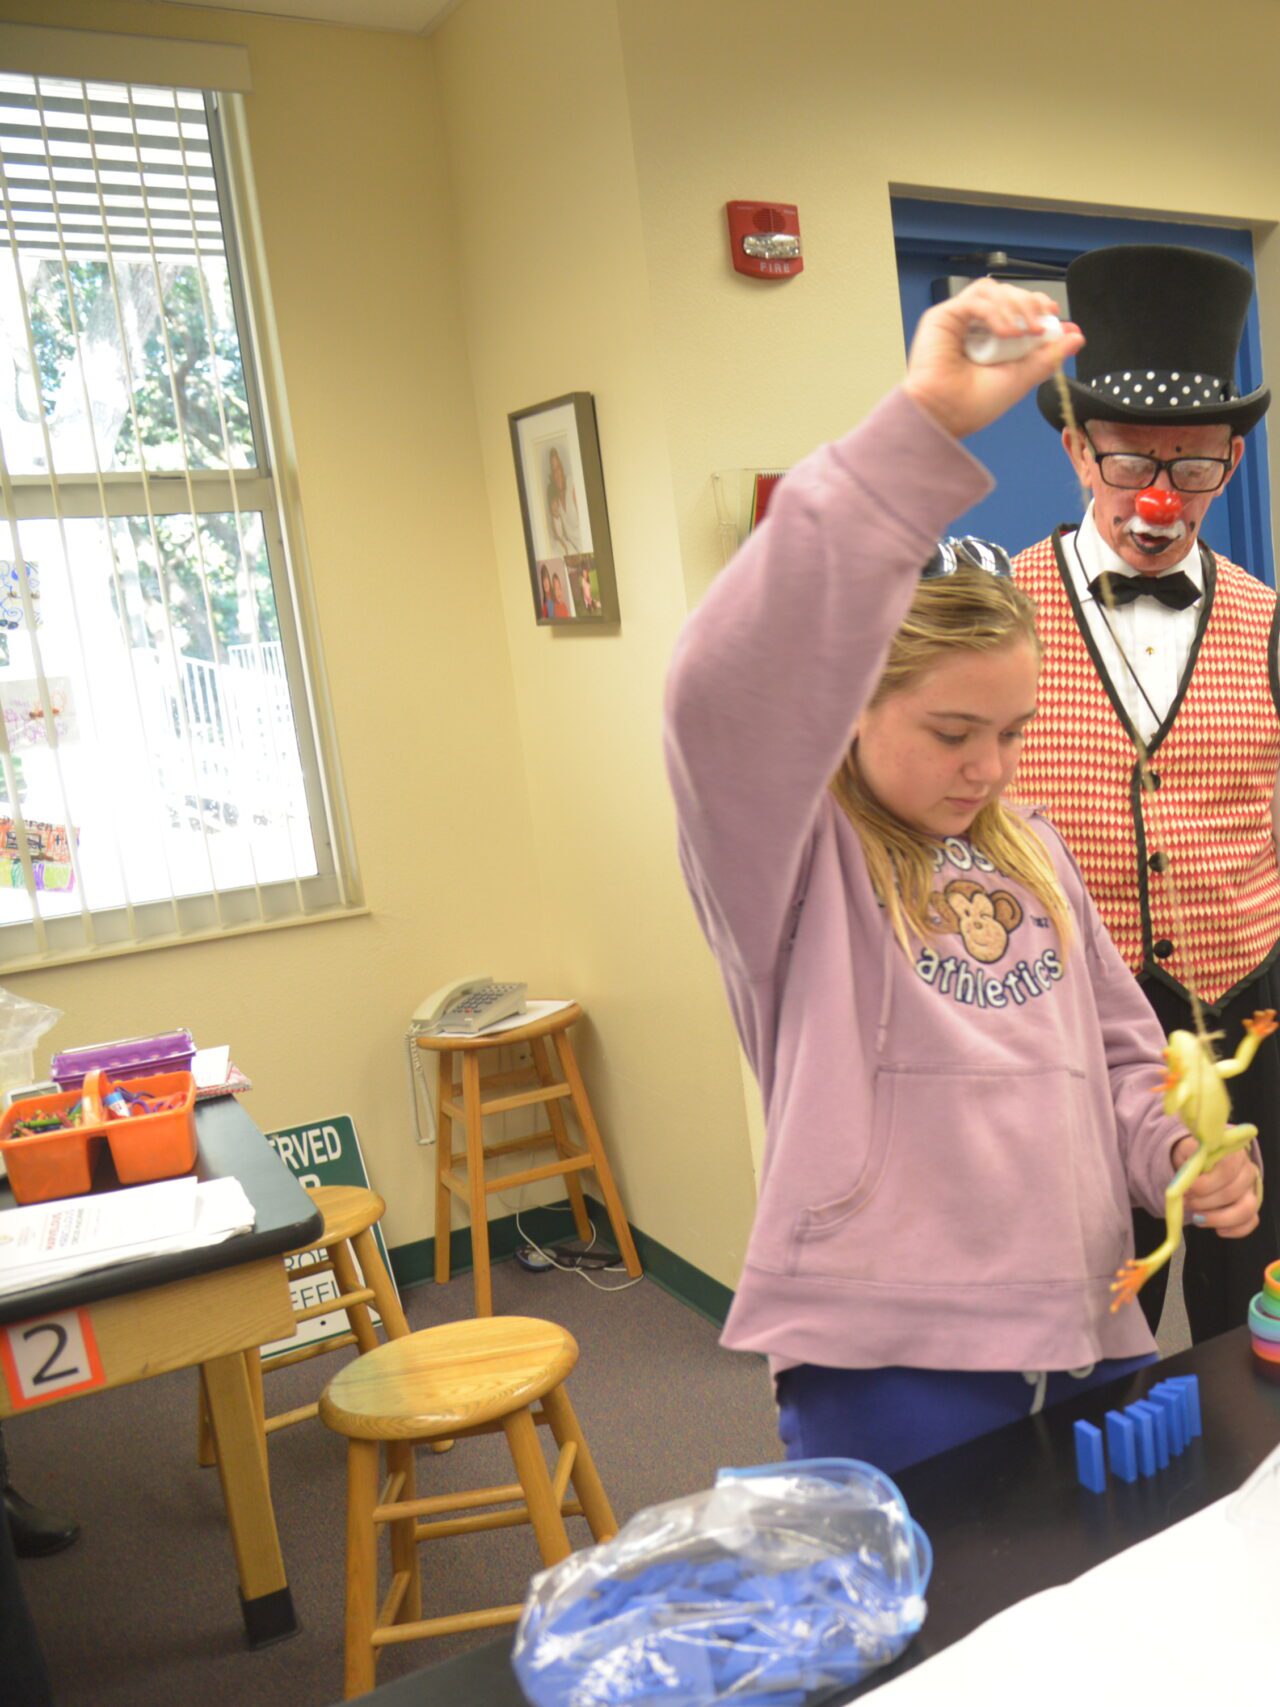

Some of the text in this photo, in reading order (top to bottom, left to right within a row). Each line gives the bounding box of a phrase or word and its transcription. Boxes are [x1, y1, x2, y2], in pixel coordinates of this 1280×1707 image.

[759, 262, 791, 273] FIRE
[915, 948, 1064, 1008] athletics
[268, 1125, 342, 1170] RVED
[23, 1323, 80, 1386] 2
